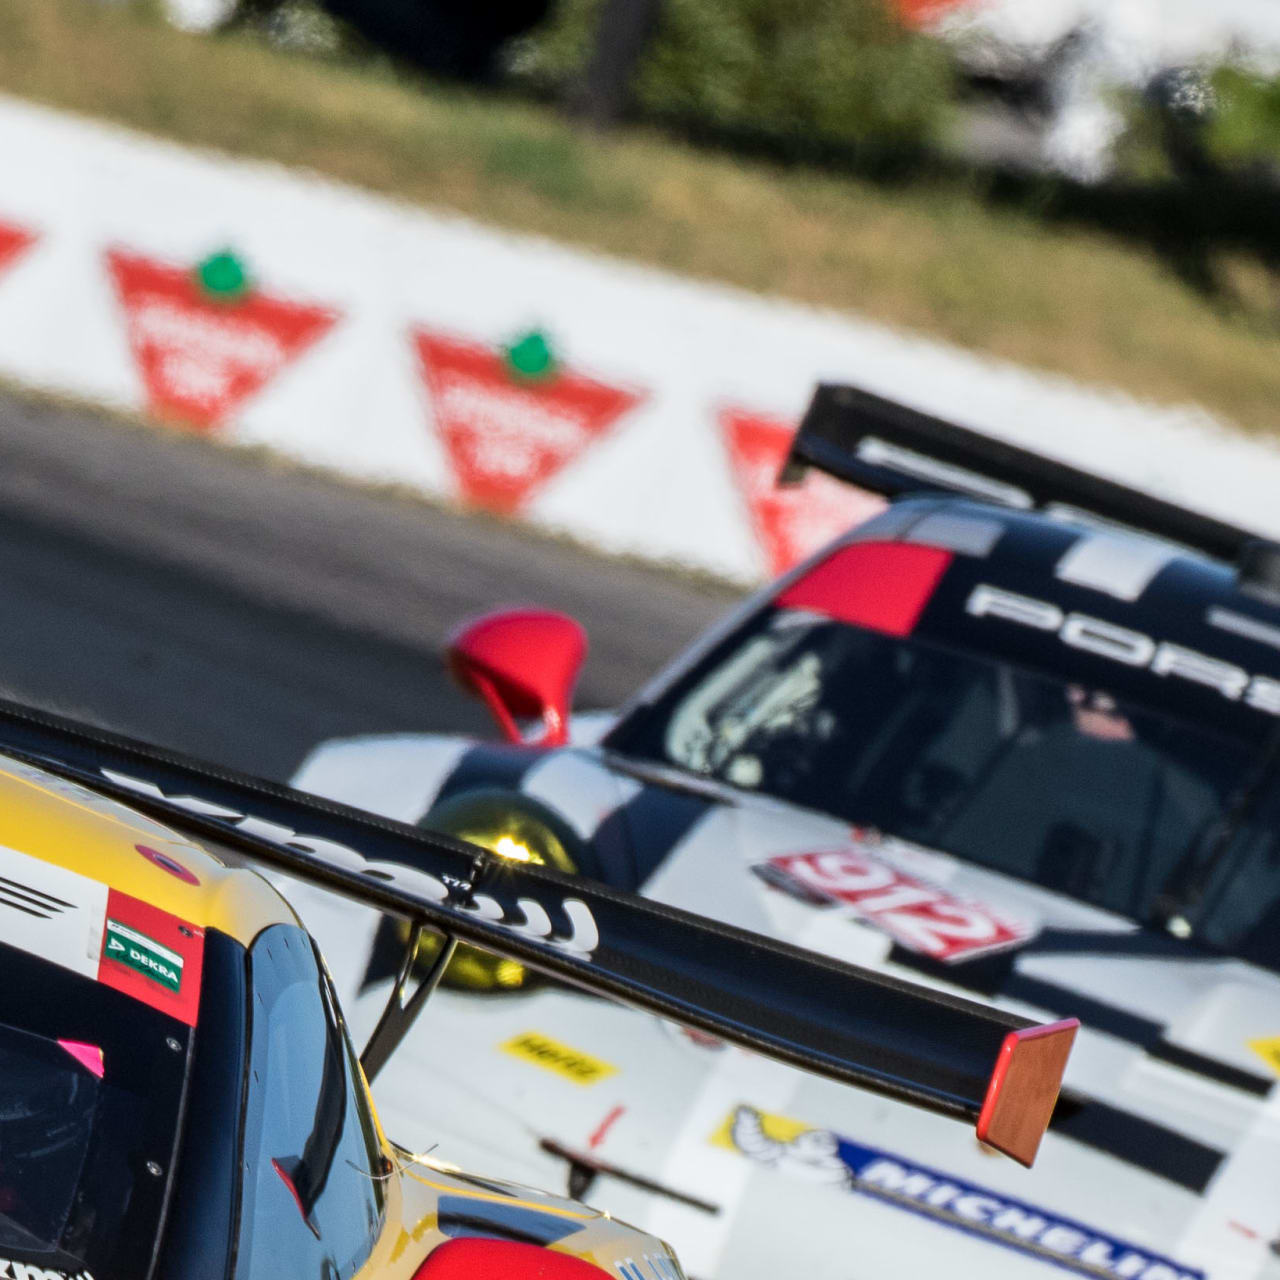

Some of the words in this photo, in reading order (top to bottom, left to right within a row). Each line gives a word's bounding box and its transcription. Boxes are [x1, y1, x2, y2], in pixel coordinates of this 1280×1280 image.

[788, 853, 996, 954] 912
[129, 947, 179, 984] DEKRA
[518, 1037, 598, 1078] Hertz
